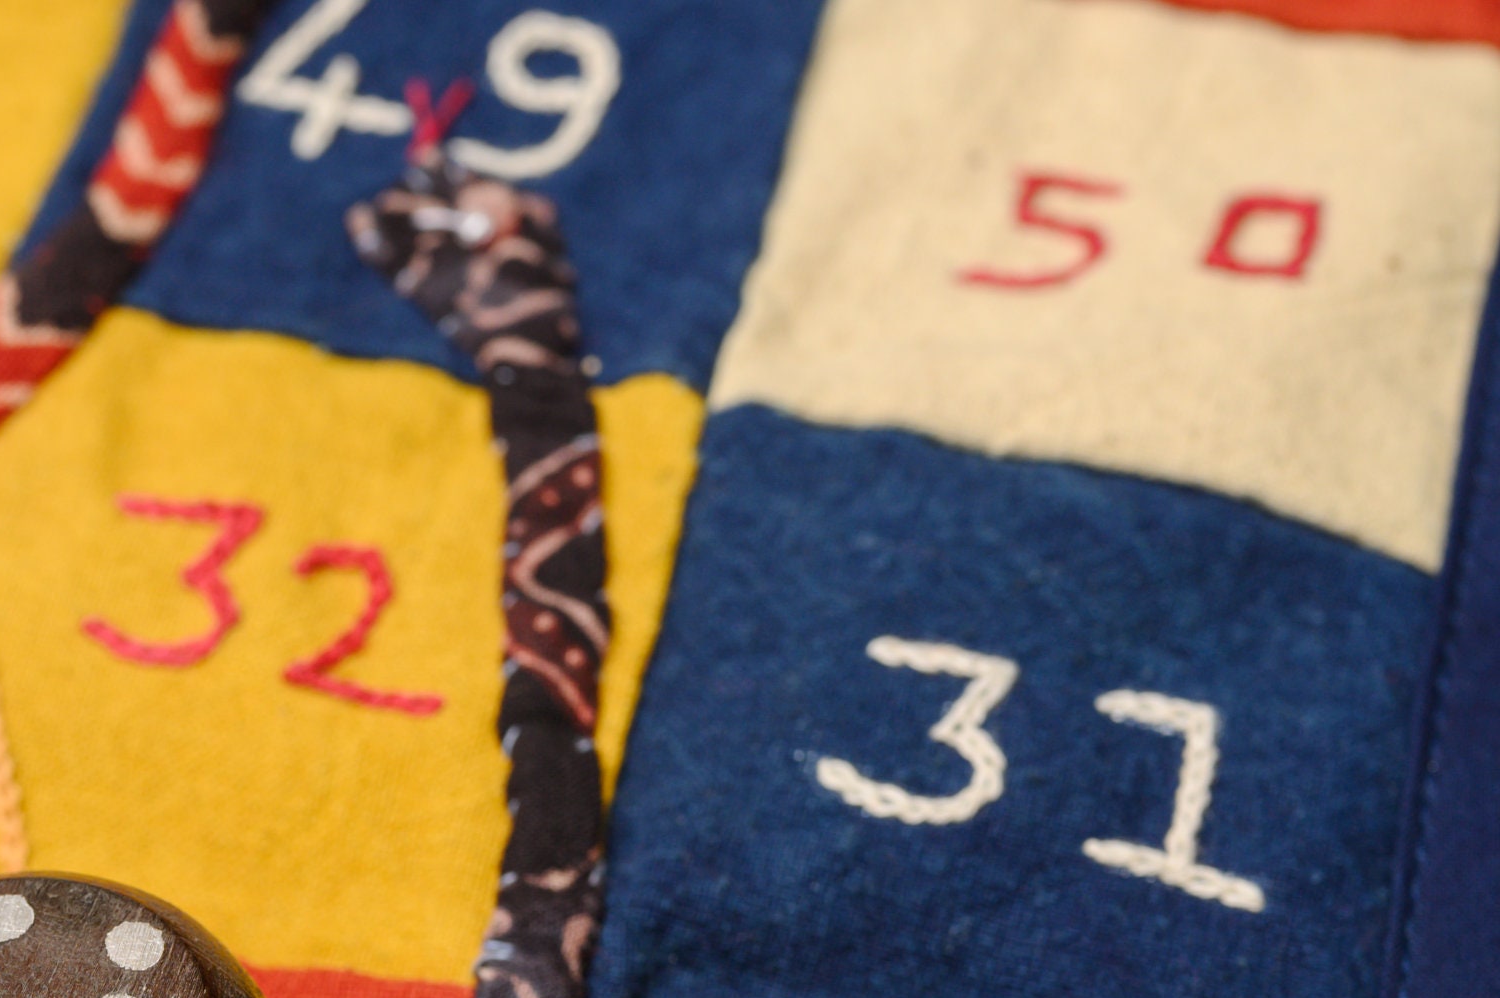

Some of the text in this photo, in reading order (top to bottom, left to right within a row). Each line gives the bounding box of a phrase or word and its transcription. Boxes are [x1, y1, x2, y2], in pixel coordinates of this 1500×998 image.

[235, 0, 622, 181] 49
[950, 167, 1327, 292] 50
[79, 490, 447, 719] 32
[814, 634, 1267, 913] 31
